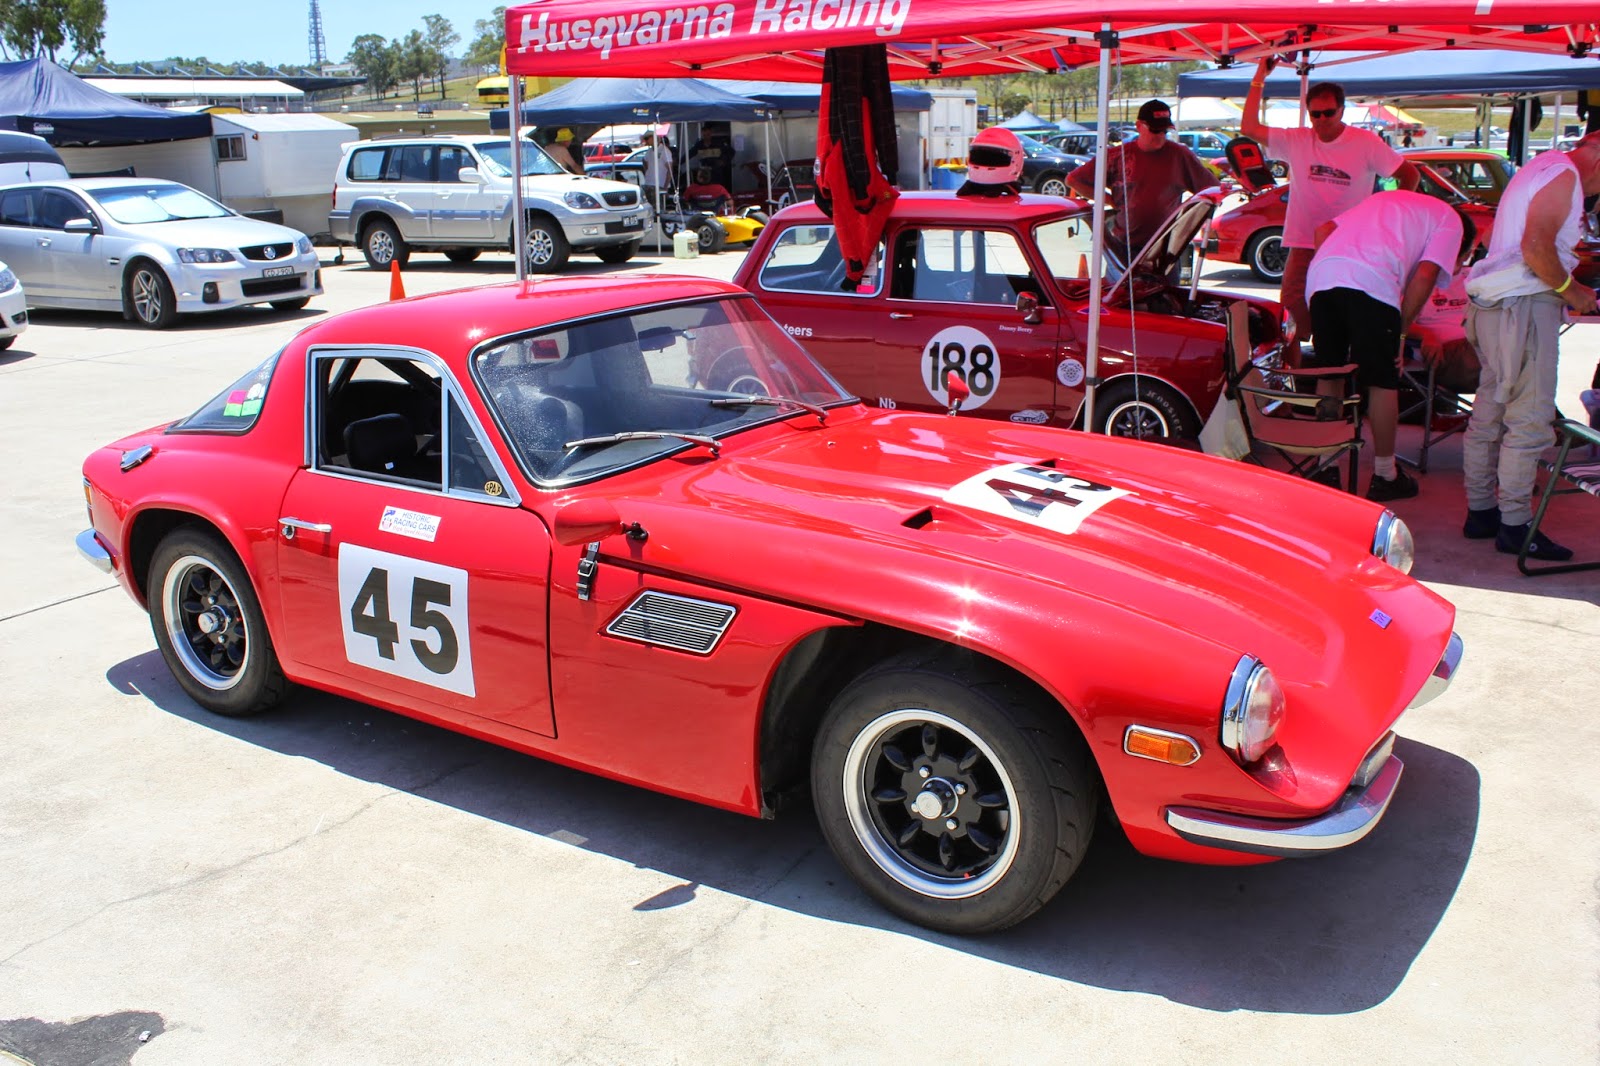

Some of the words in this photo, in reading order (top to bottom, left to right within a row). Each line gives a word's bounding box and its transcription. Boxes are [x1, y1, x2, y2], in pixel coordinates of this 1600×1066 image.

[517, 4, 733, 59] Husqvarna
[748, 0, 912, 36] Racing
[929, 341, 995, 397] 188
[879, 397, 897, 410] Nb
[402, 512, 432, 524] HISTORIC
[984, 466, 1113, 518] 45
[393, 517, 418, 529] RACING
[418, 523, 436, 533] CARS
[350, 566, 459, 675] 45
